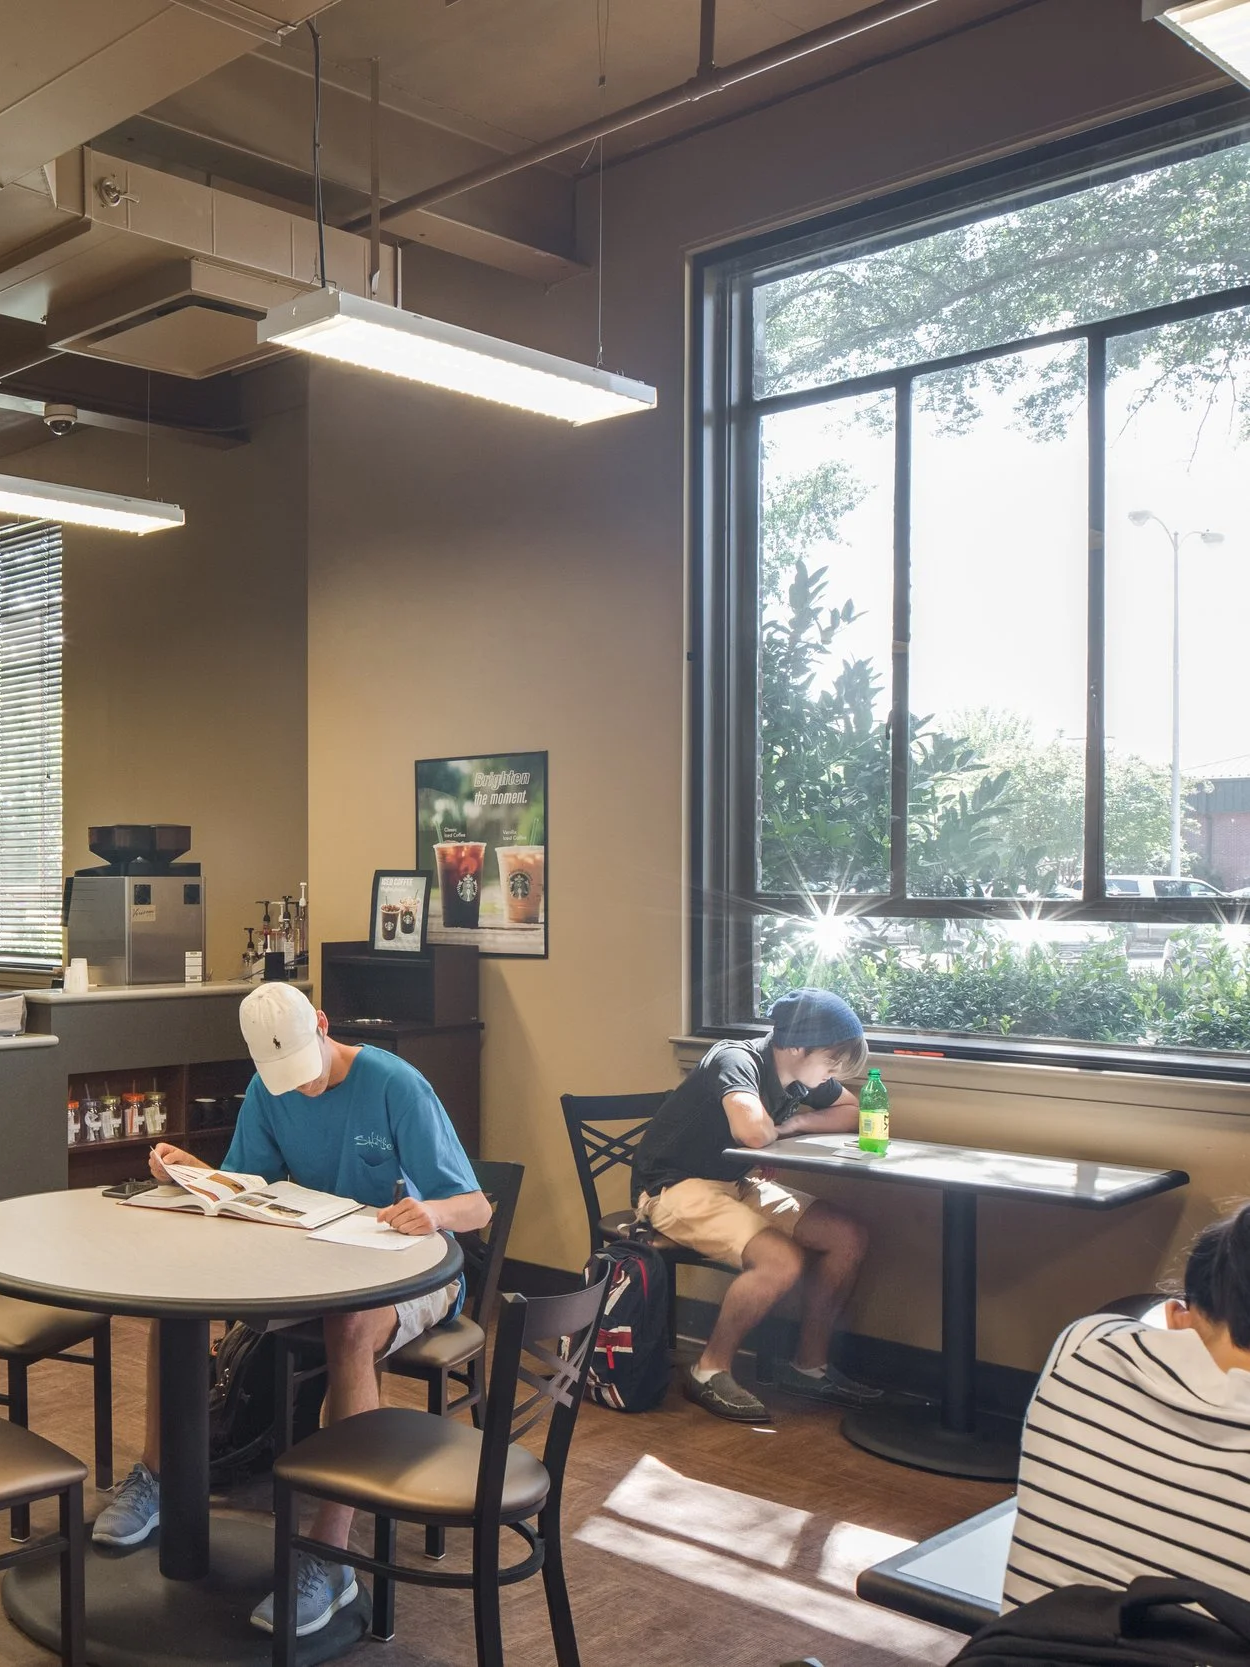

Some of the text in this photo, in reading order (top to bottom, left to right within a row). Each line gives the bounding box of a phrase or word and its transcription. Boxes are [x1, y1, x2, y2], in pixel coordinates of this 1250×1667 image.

[474, 770, 530, 790] Brighten
[475, 789, 528, 805] the moment.
